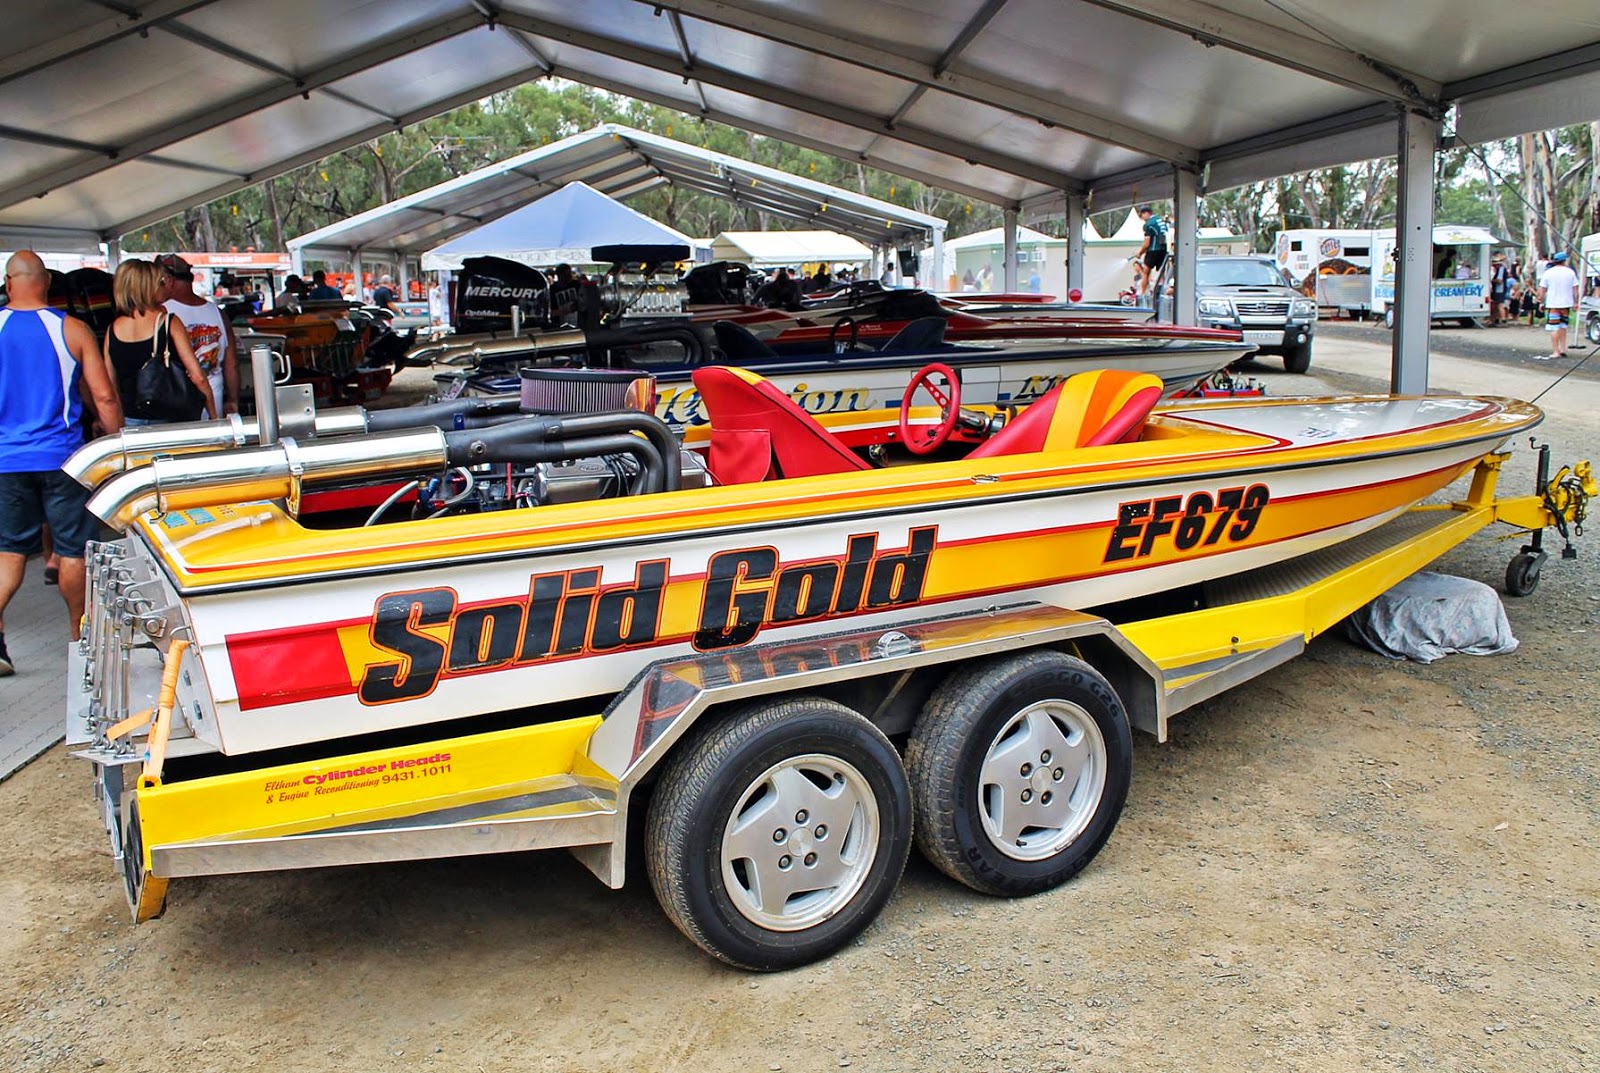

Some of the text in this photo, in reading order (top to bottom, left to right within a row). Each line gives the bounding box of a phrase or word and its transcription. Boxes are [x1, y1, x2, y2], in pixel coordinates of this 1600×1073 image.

[465, 285, 543, 299] MERCURY
[1434, 285, 1483, 297] CREAMERY
[1101, 481, 1270, 565] EF679
[357, 523, 939, 707] Solid Gold
[264, 753, 451, 792] Eltham Cylinder Heads
[266, 764, 452, 804] & Engine Reconditioning 9431.1011
